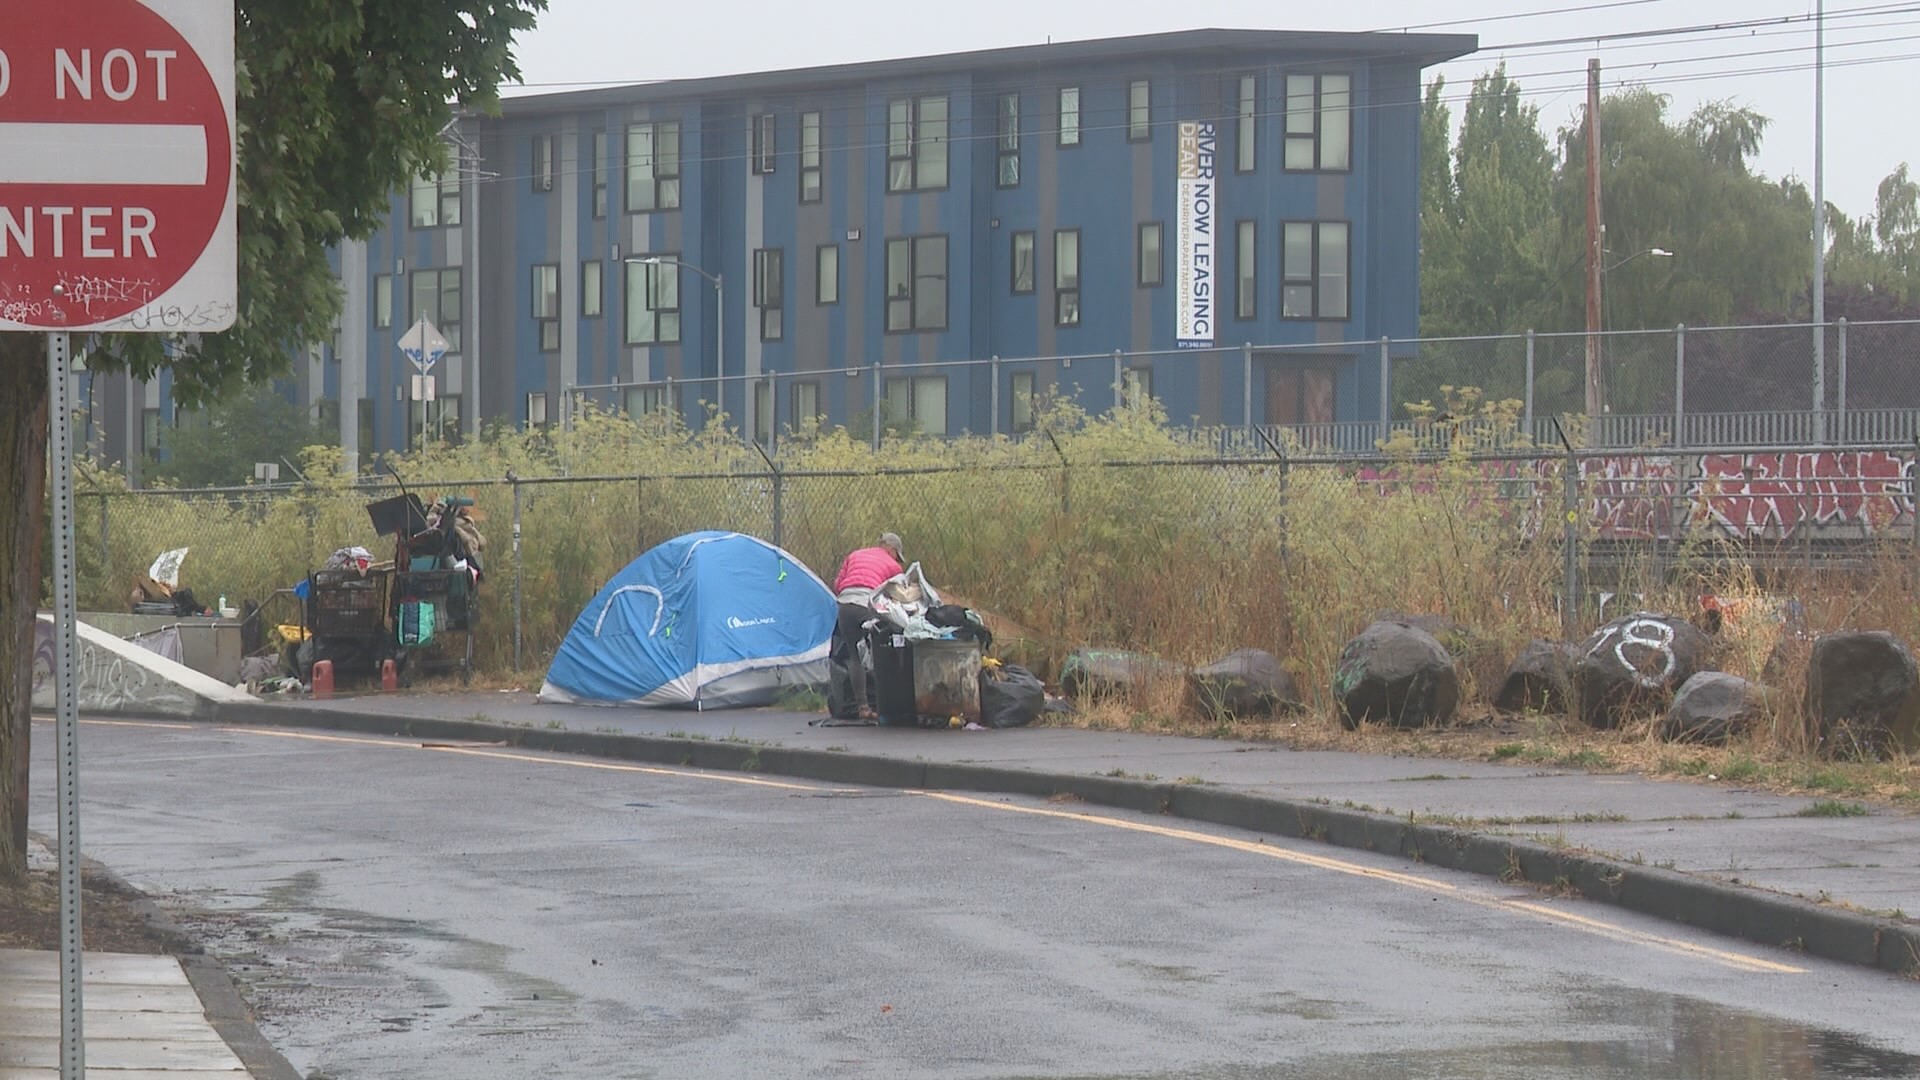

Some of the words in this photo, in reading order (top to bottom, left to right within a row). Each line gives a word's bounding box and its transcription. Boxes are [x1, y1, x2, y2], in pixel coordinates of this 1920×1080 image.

[55, 48, 177, 101] NOT
[1181, 123, 1196, 177] DEAN
[1198, 121, 1215, 179] RIVER
[1194, 184, 1210, 235] NOW
[1181, 184, 1189, 334] DEANRIVERAPARTMENTS.COM
[1193, 243, 1209, 336] LEASING
